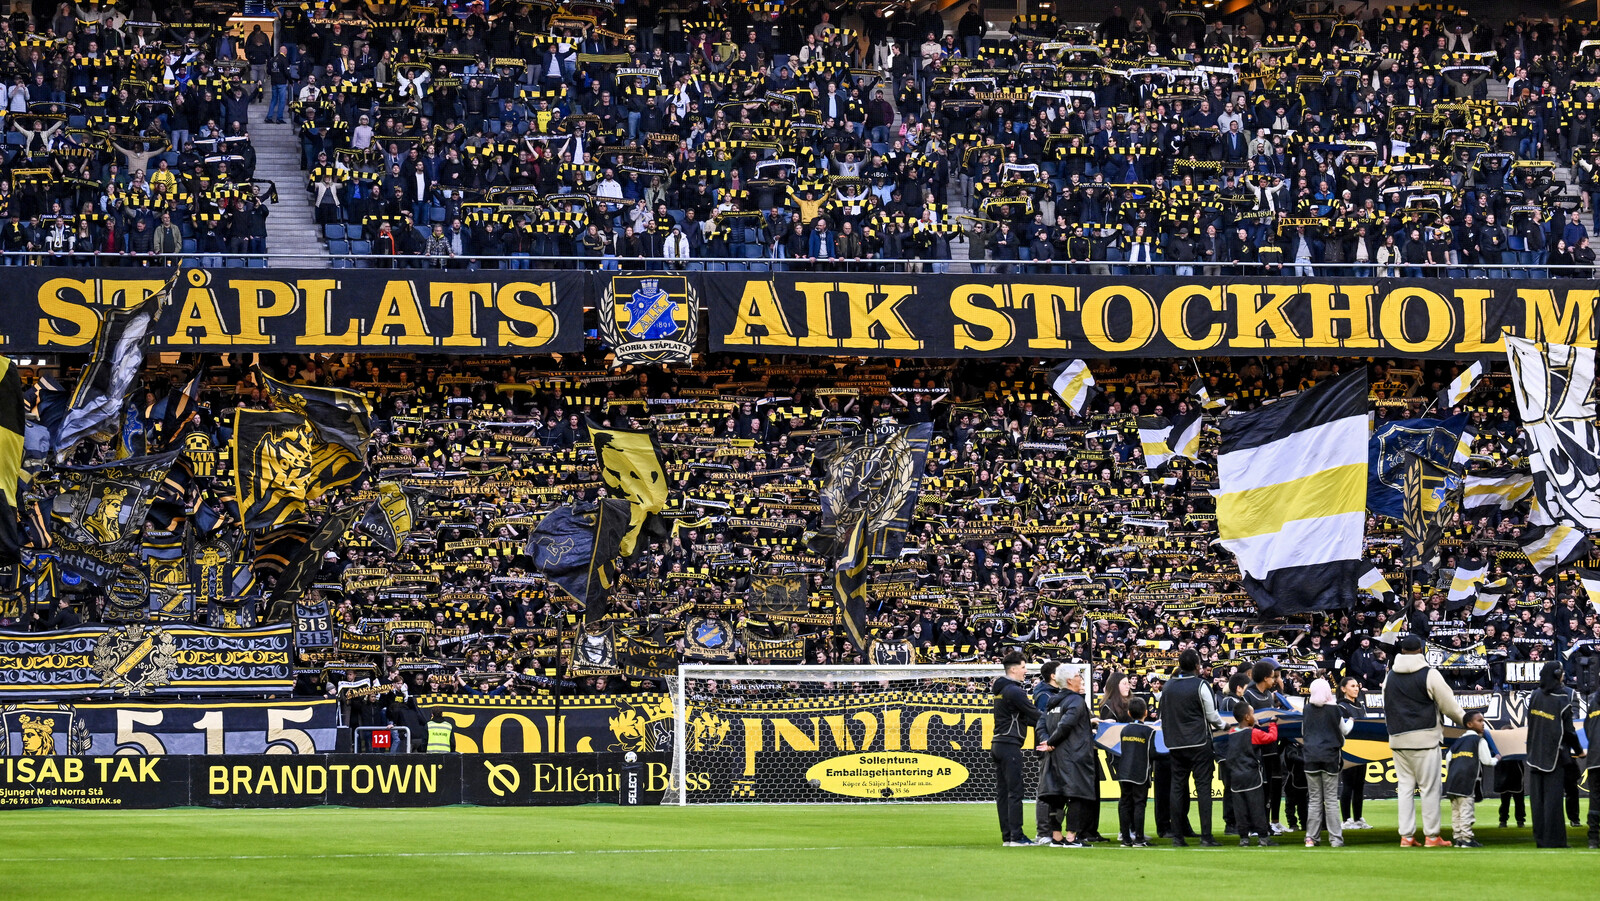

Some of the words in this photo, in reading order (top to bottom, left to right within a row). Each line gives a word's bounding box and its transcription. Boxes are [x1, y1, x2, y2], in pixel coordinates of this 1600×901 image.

[37, 269, 559, 347] STÅPLATS
[723, 280, 924, 350] AIK
[949, 284, 1600, 353] STOCKHOLM
[619, 344, 647, 353] NORRA
[649, 341, 688, 352] STÅPLATS
[743, 519, 786, 529] STOCKHOLM
[298, 617, 327, 631] 515
[341, 642, 380, 651] 1937-2012
[757, 649, 803, 658] UPPROR
[373, 734, 389, 745] 121
[859, 756, 918, 765] Sollentuna
[0, 758, 85, 783] ISAB
[94, 757, 161, 783] TAK
[826, 767, 933, 779] Emballagehantering
[936, 767, 952, 777] AB
[0, 788, 35, 798] Sjunger
[37, 788, 57, 796] Med
[60, 788, 86, 796] Norra
[88, 786, 104, 796] Stå
[628, 772, 638, 805] SELECT
[52, 797, 122, 805] www.TISABTAK.se
